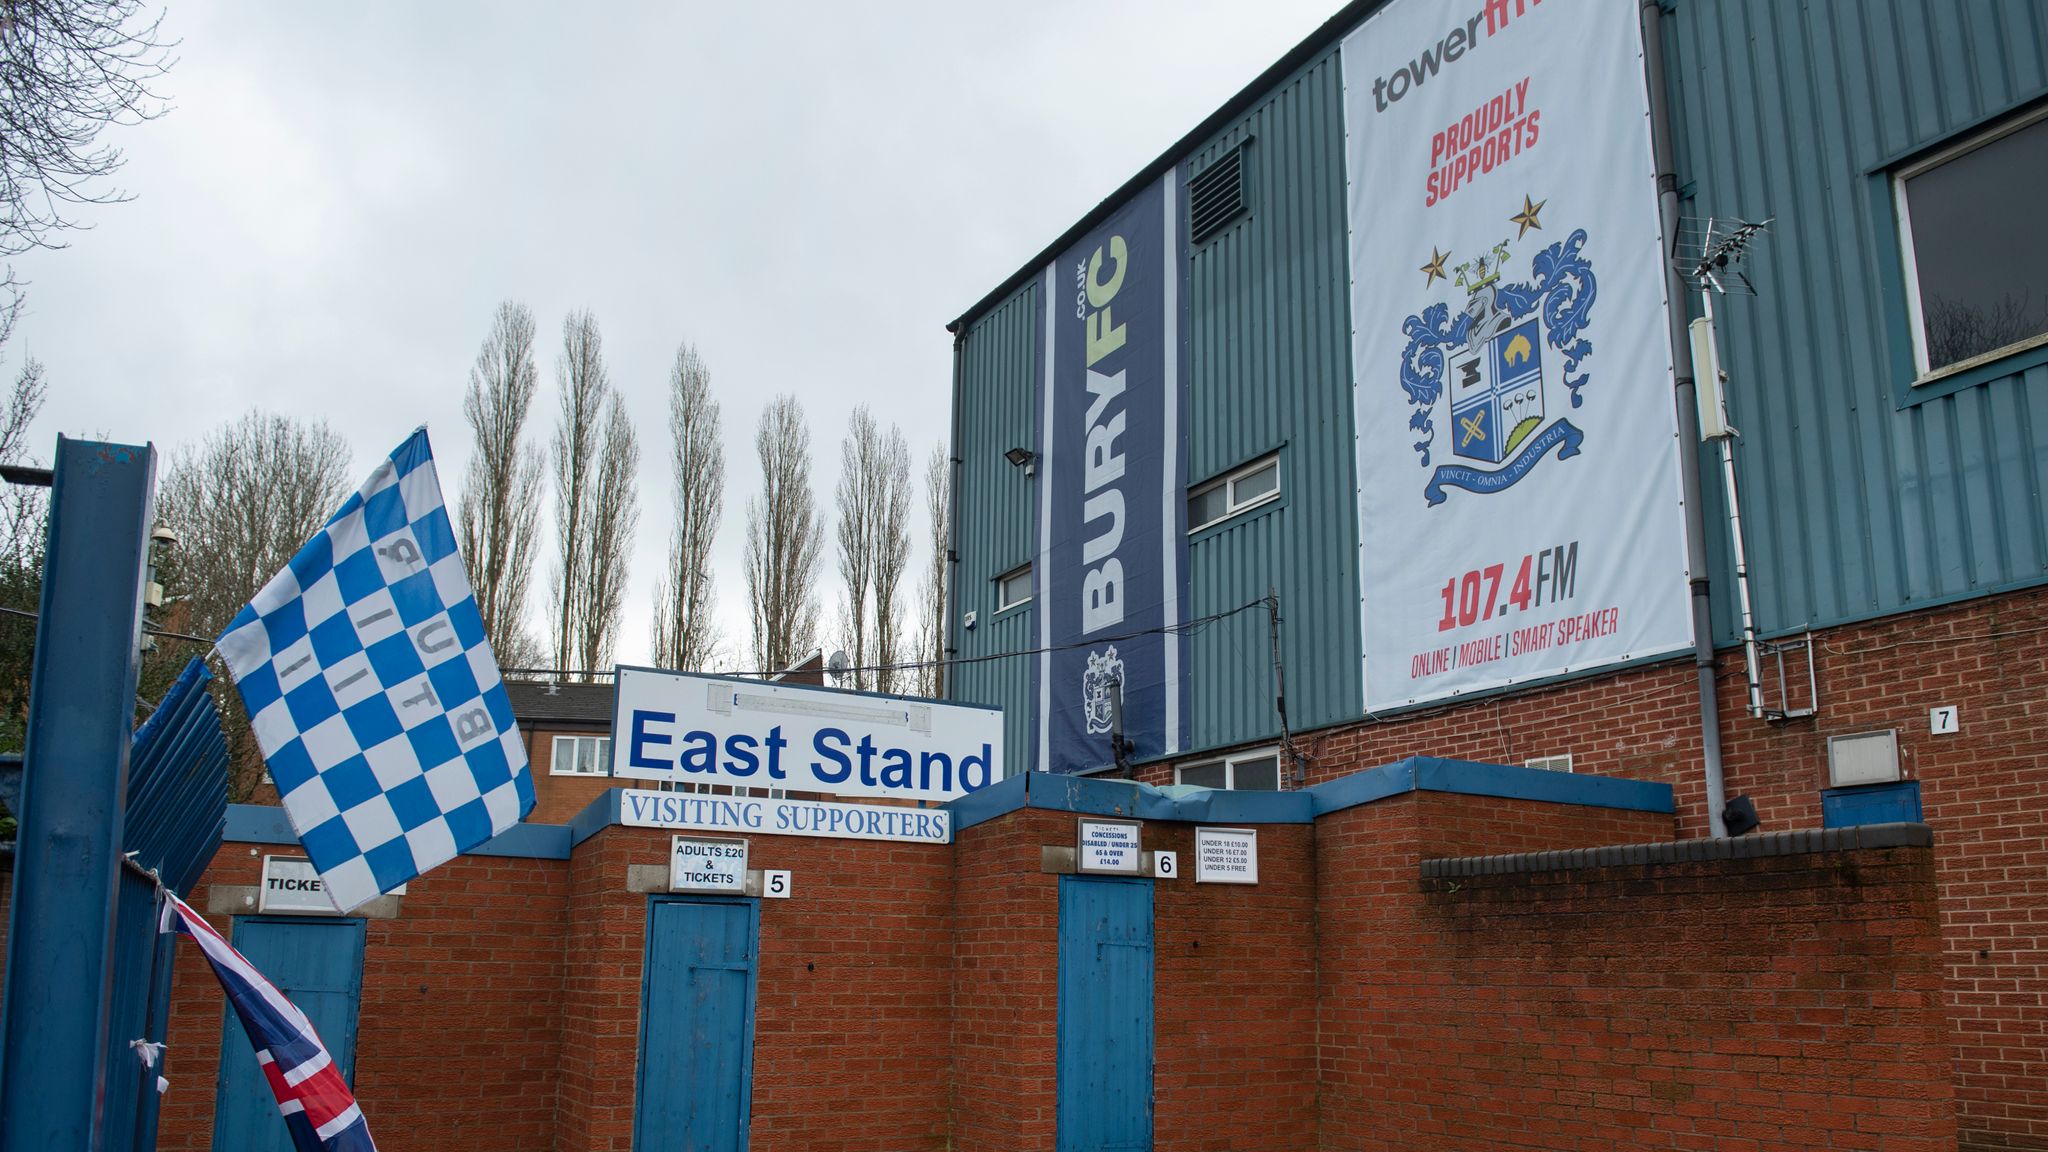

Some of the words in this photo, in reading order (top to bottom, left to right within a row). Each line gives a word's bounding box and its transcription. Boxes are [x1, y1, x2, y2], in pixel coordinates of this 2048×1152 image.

[1430, 76, 1530, 168] PROUDLY
[1426, 109, 1541, 208] SUPPORTS
[1440, 470, 1472, 481] VINCIT
[1477, 475, 1508, 486] OMNIA
[1513, 426, 1565, 474] INDUSTRIA
[1438, 541, 1579, 632] 107.4FM
[1411, 647, 1449, 679] ONLINE
[1458, 634, 1501, 668] MOBILE
[1512, 622, 1555, 657] SMART
[1557, 607, 1619, 646] SPEAKER
[1939, 711, 1950, 729] 7
[629, 709, 787, 780] East
[810, 727, 992, 794] Stand
[629, 795, 762, 829] VISITING
[776, 804, 945, 840] SUPPORTERS
[1091, 831, 1127, 839] CONCESSIONS
[676, 845, 722, 857] ADULTS
[725, 847, 744, 858] £20
[705, 860, 714, 870] &
[1160, 855, 1172, 873] 6
[267, 878, 327, 892] TICKE
[684, 871, 734, 884] TICKETS
[770, 875, 784, 893] 5
